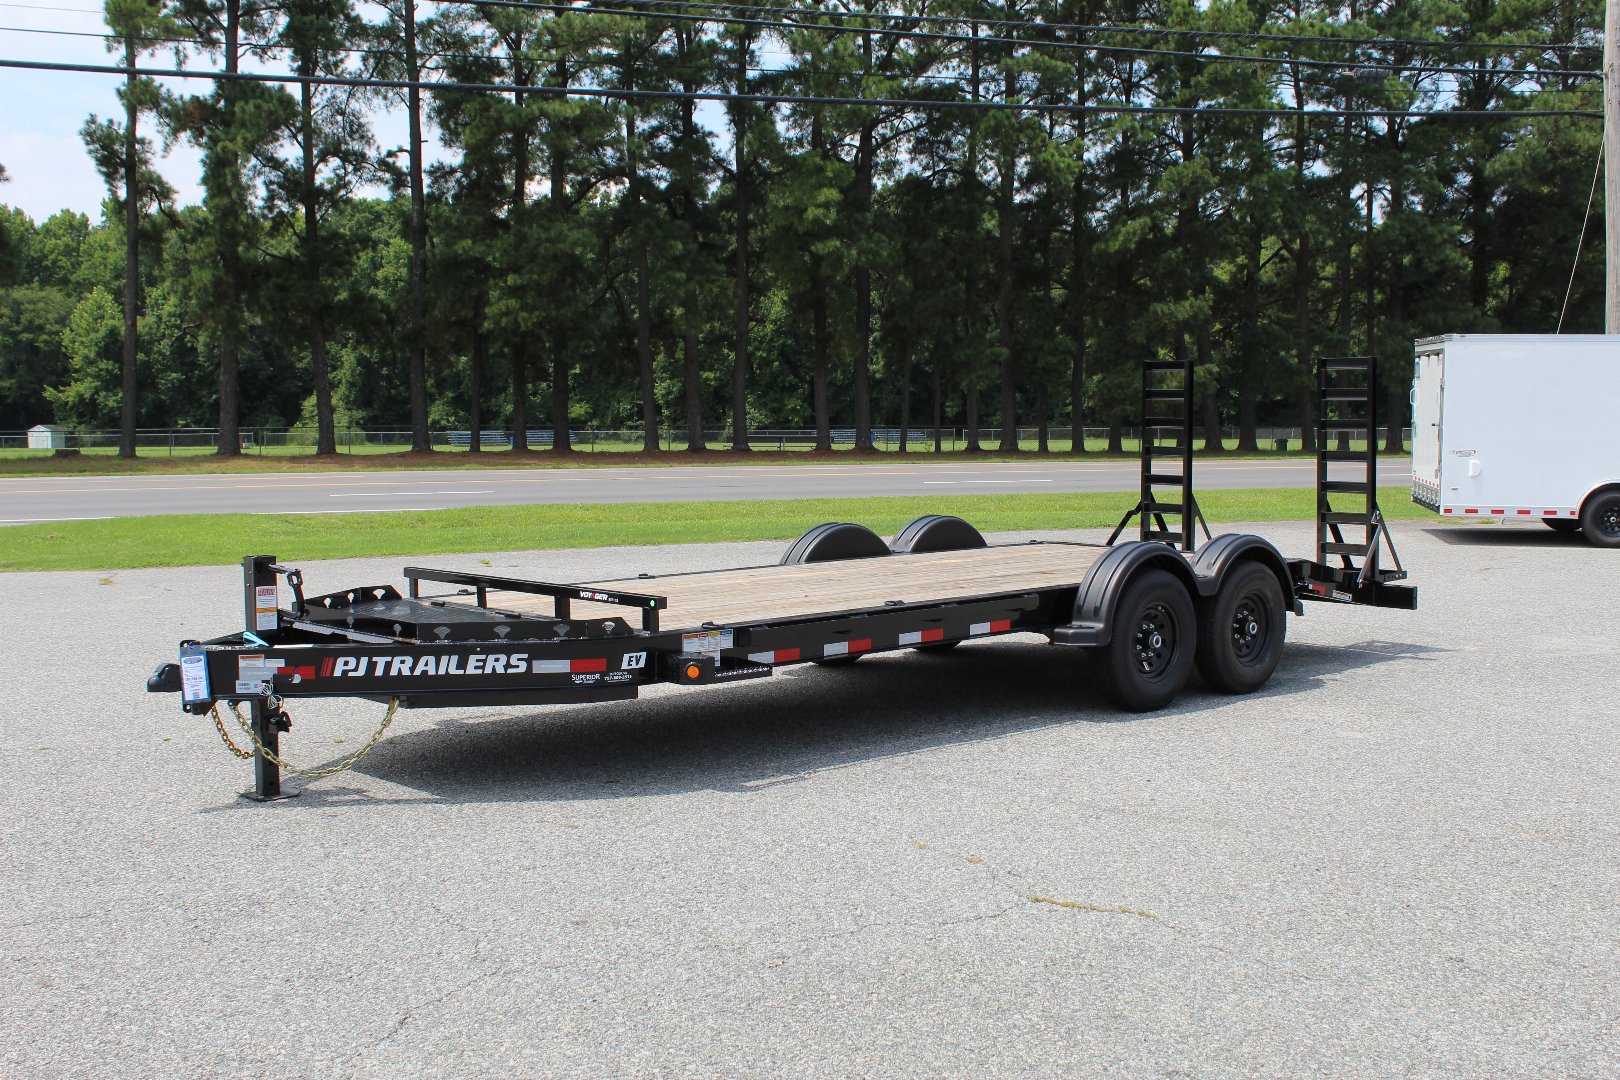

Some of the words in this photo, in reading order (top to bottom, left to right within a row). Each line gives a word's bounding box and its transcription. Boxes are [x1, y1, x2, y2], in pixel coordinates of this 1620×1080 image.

[580, 591, 608, 600] VOYAGER
[626, 654, 643, 667] EV
[571, 673, 601, 681] SUPERIOR
